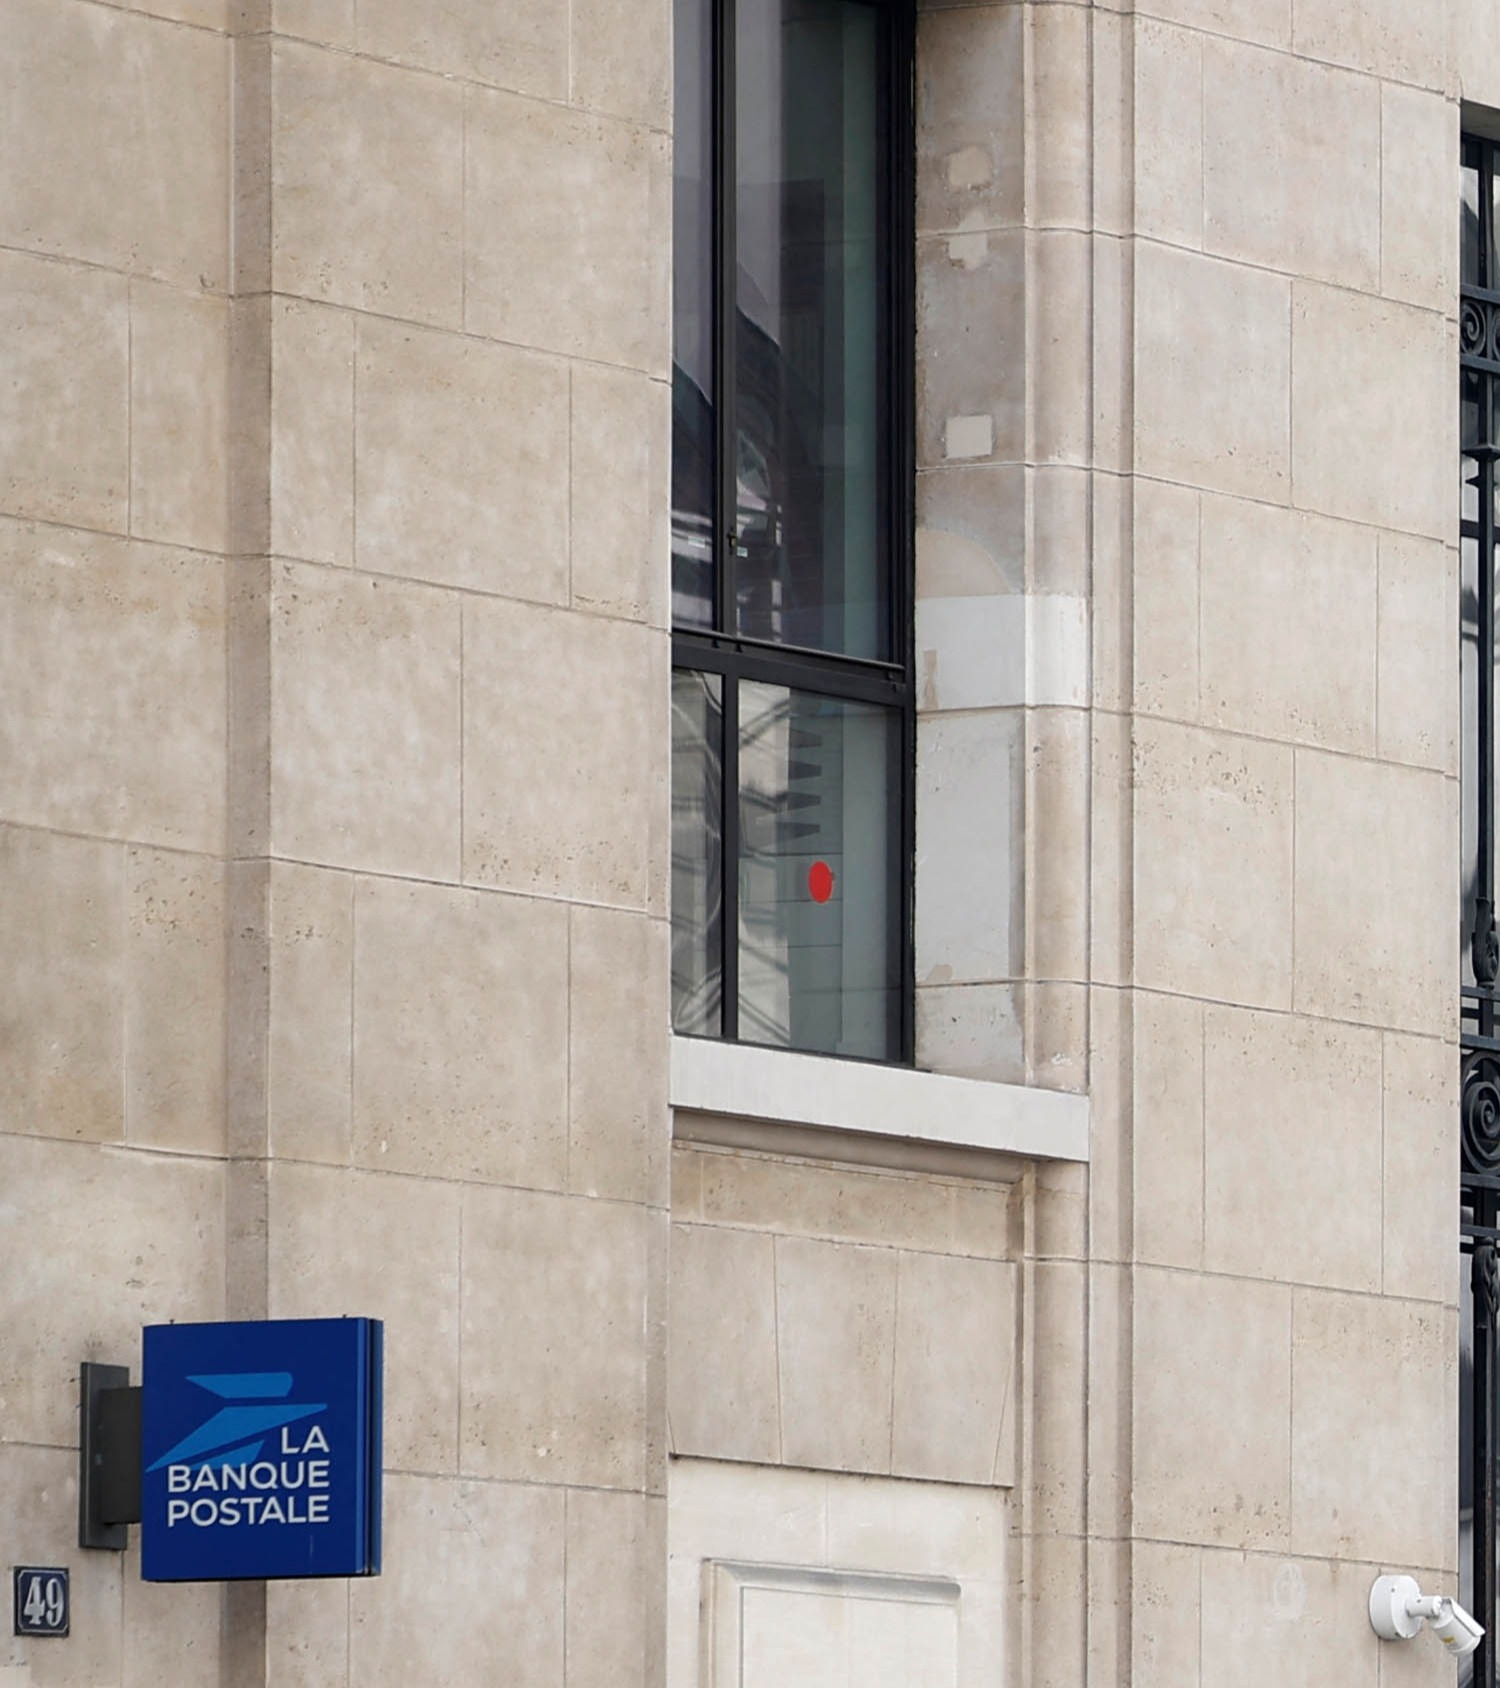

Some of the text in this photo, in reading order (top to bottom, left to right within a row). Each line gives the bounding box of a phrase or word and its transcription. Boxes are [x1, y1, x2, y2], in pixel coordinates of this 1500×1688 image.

[281, 1425, 330, 1455] LA
[167, 1460, 330, 1493] BANQUE
[167, 1495, 330, 1528] POSTALE
[23, 1576, 65, 1627] 49
